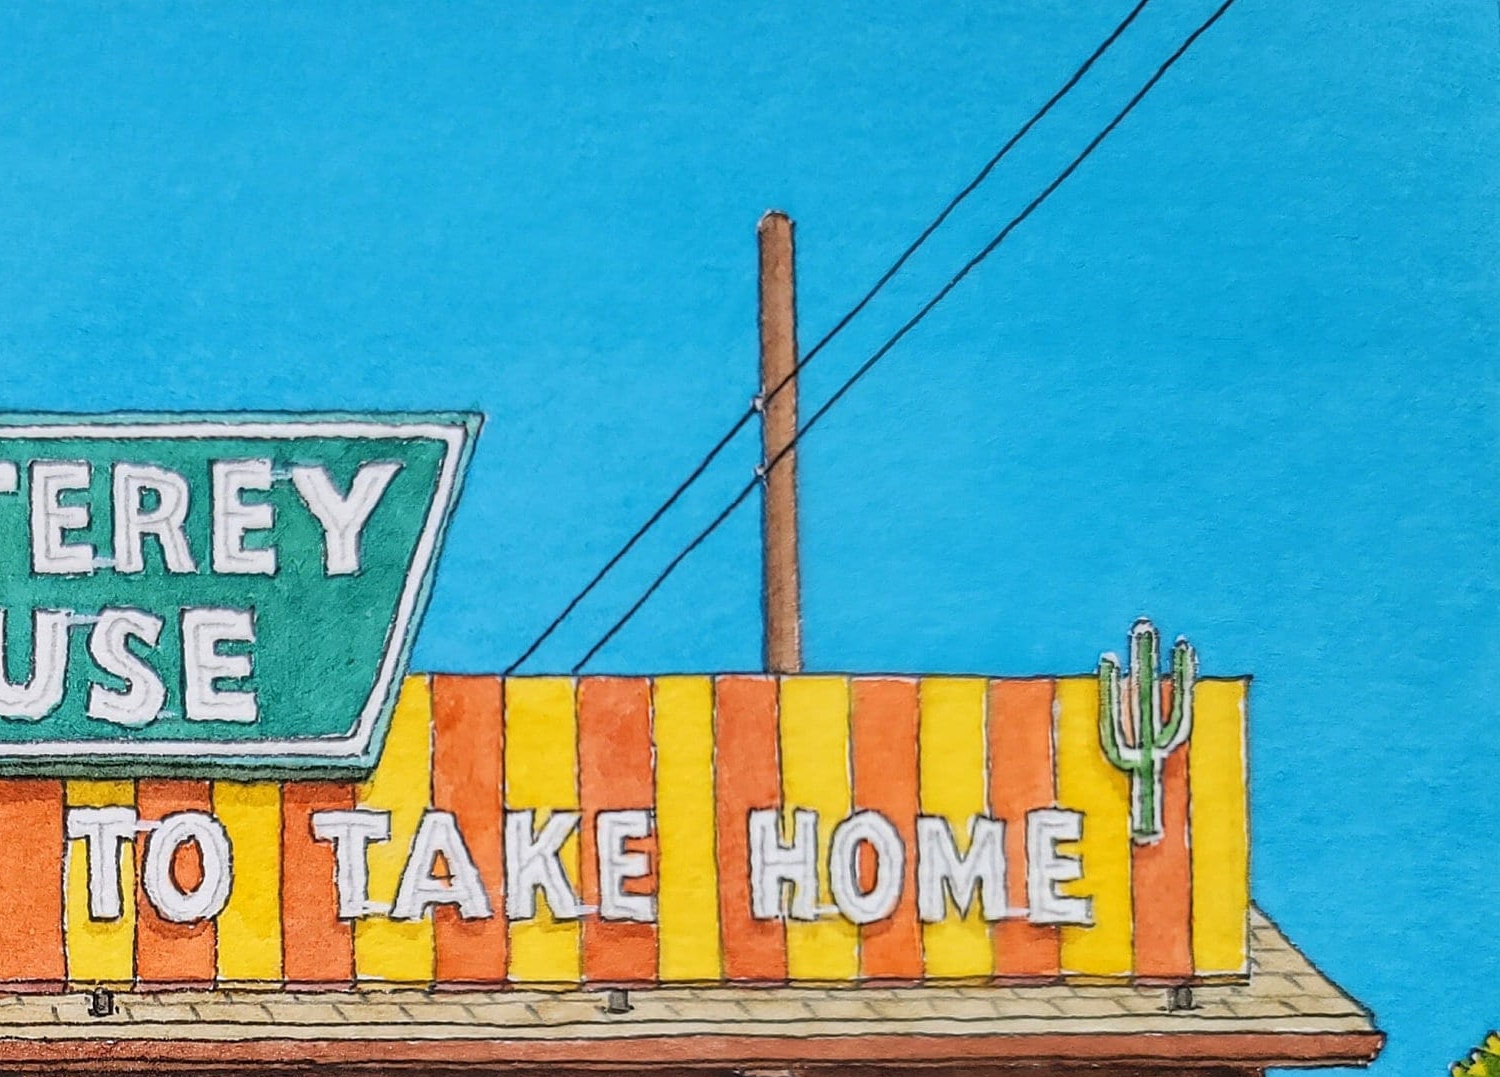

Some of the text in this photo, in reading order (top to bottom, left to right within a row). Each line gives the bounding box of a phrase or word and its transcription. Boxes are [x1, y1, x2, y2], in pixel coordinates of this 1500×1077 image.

[68, 805, 233, 924] TO
[312, 808, 657, 923] TAKE
[748, 807, 1094, 925] HOME
